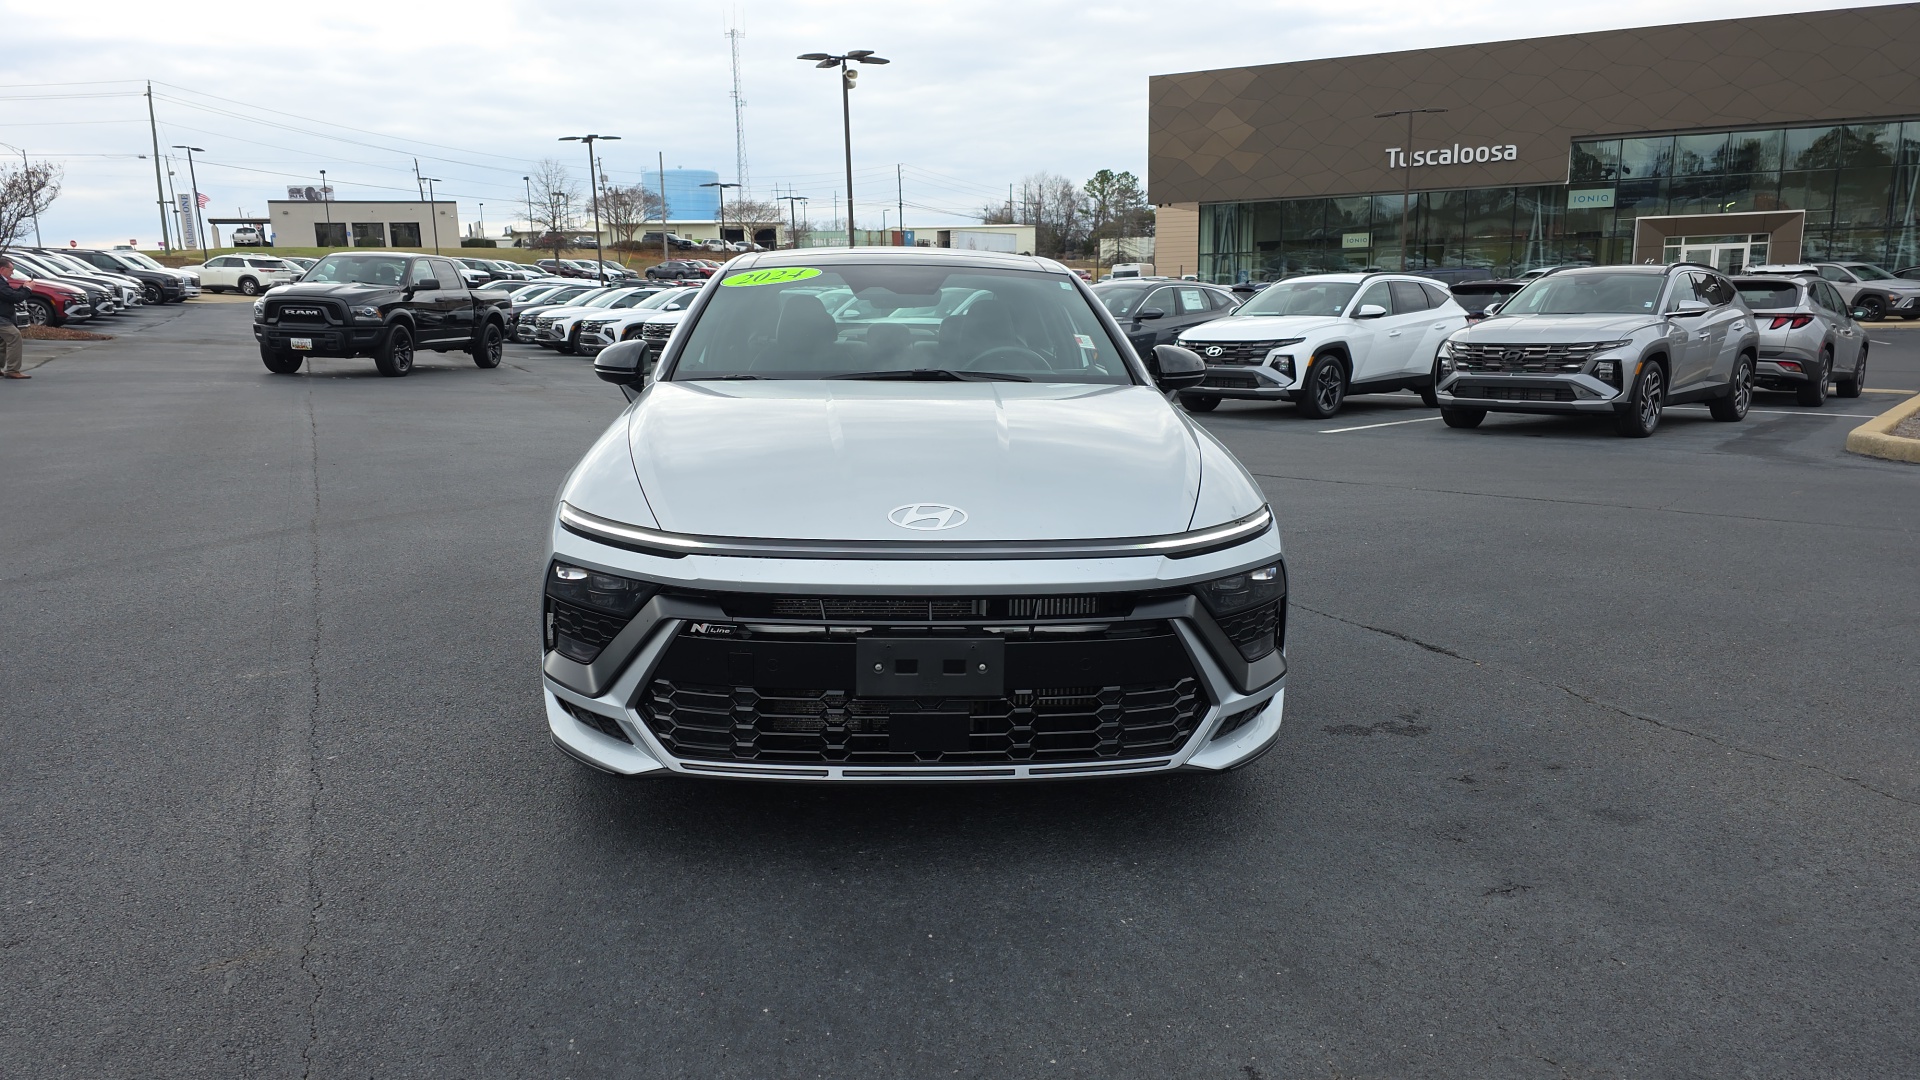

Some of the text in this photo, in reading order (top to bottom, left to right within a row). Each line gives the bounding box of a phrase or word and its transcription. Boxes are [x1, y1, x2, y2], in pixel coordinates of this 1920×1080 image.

[1385, 143, 1517, 169] Tuscaloosa
[1573, 194, 1609, 203] IONIQ
[736, 268, 808, 285] 2024
